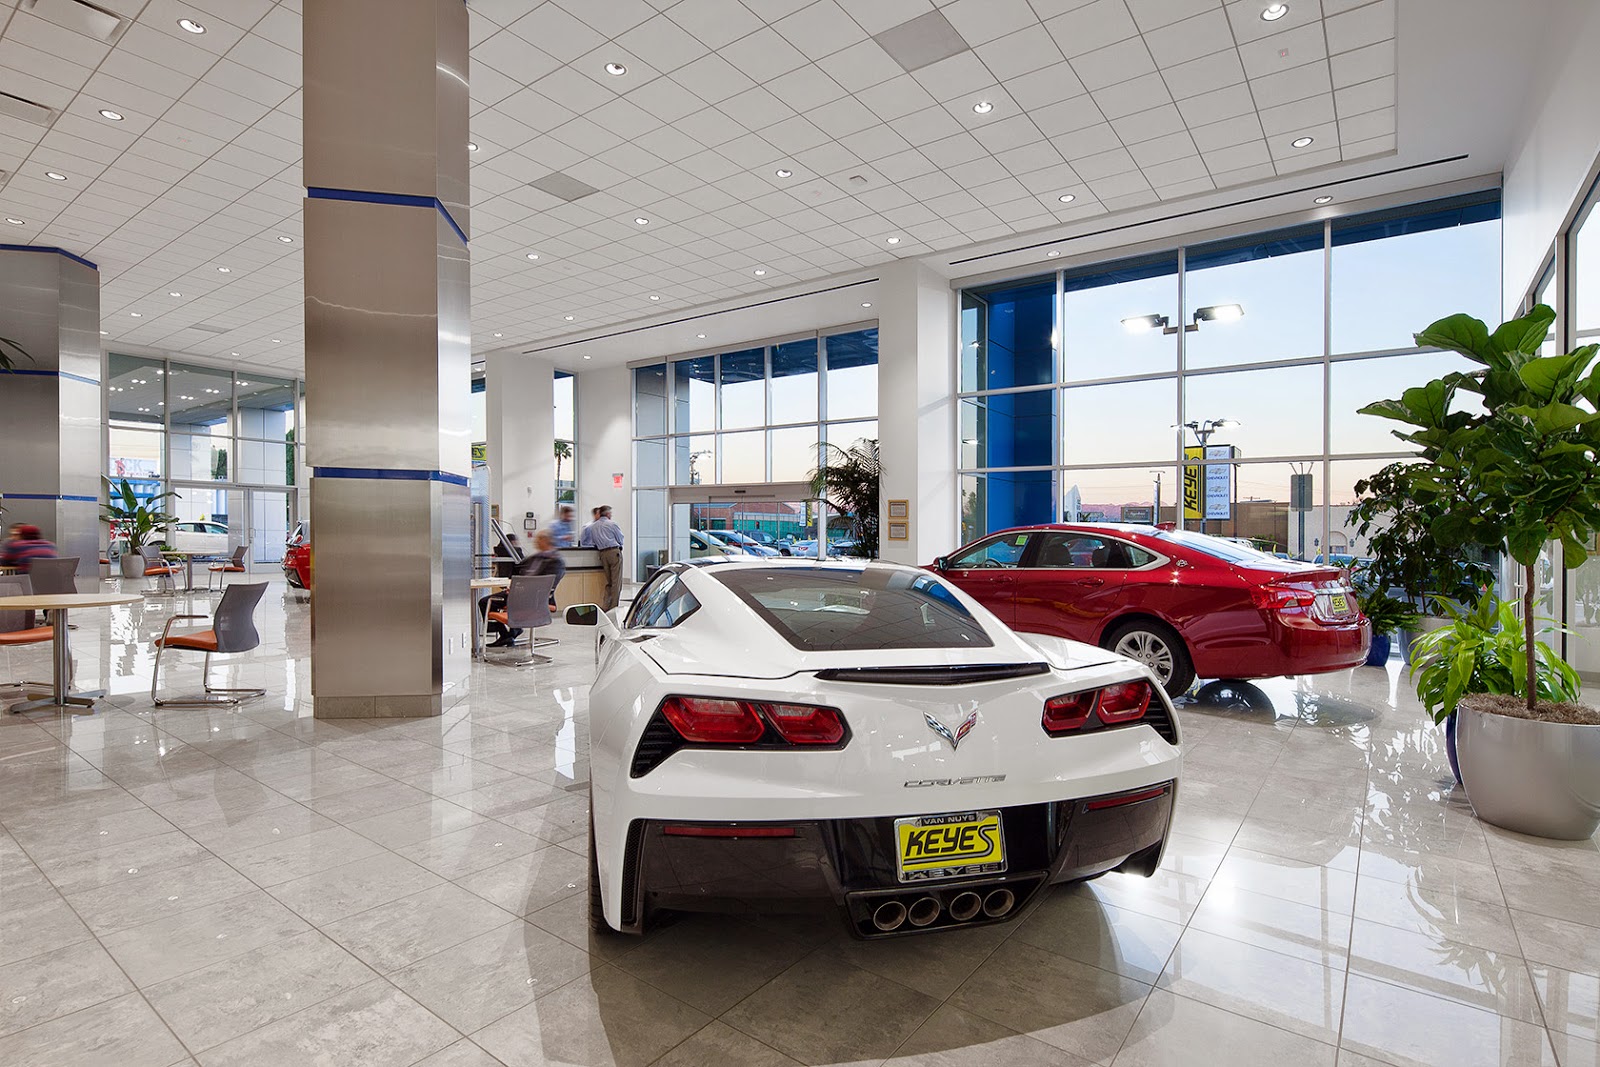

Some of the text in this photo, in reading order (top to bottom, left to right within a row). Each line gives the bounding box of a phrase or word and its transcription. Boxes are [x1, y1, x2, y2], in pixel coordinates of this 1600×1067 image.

[904, 774, 1007, 788] CORVETTE
[924, 814, 975, 825] VAN NUYS
[904, 824, 998, 865] KEYES
[909, 863, 998, 880] KEYES
